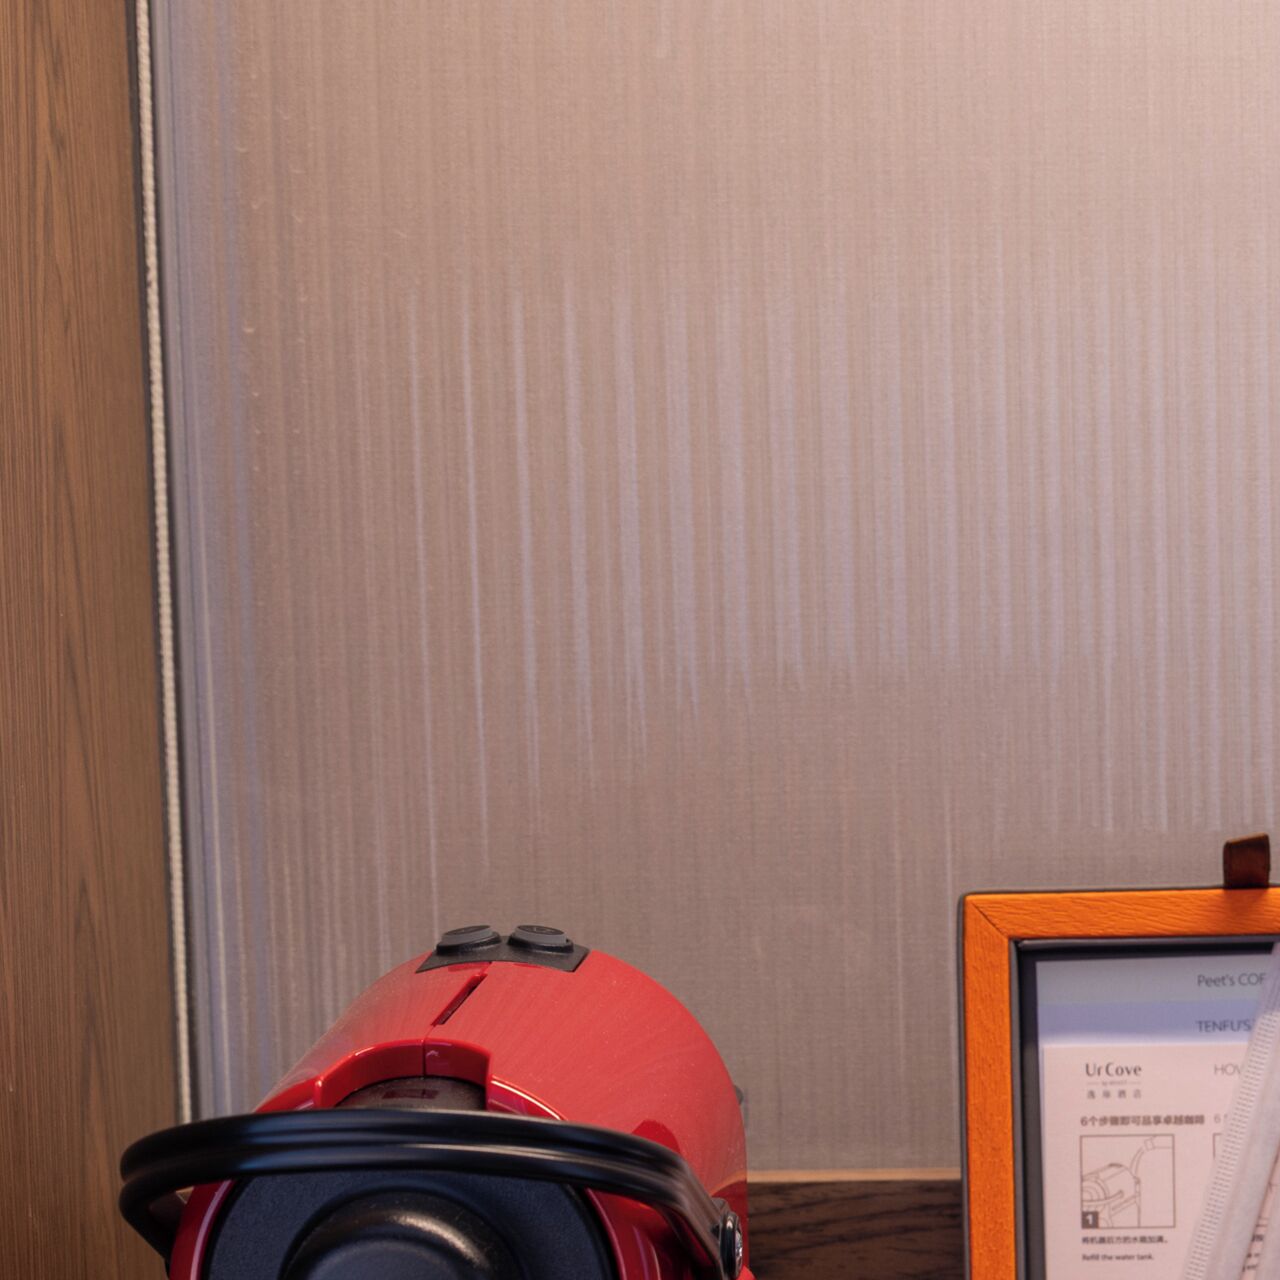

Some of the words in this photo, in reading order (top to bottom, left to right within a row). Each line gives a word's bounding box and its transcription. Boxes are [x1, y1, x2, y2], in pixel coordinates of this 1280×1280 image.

[1197, 974, 1236, 988] Peet's
[1238, 973, 1266, 986] COF
[1085, 1063, 1142, 1077] UrCove
